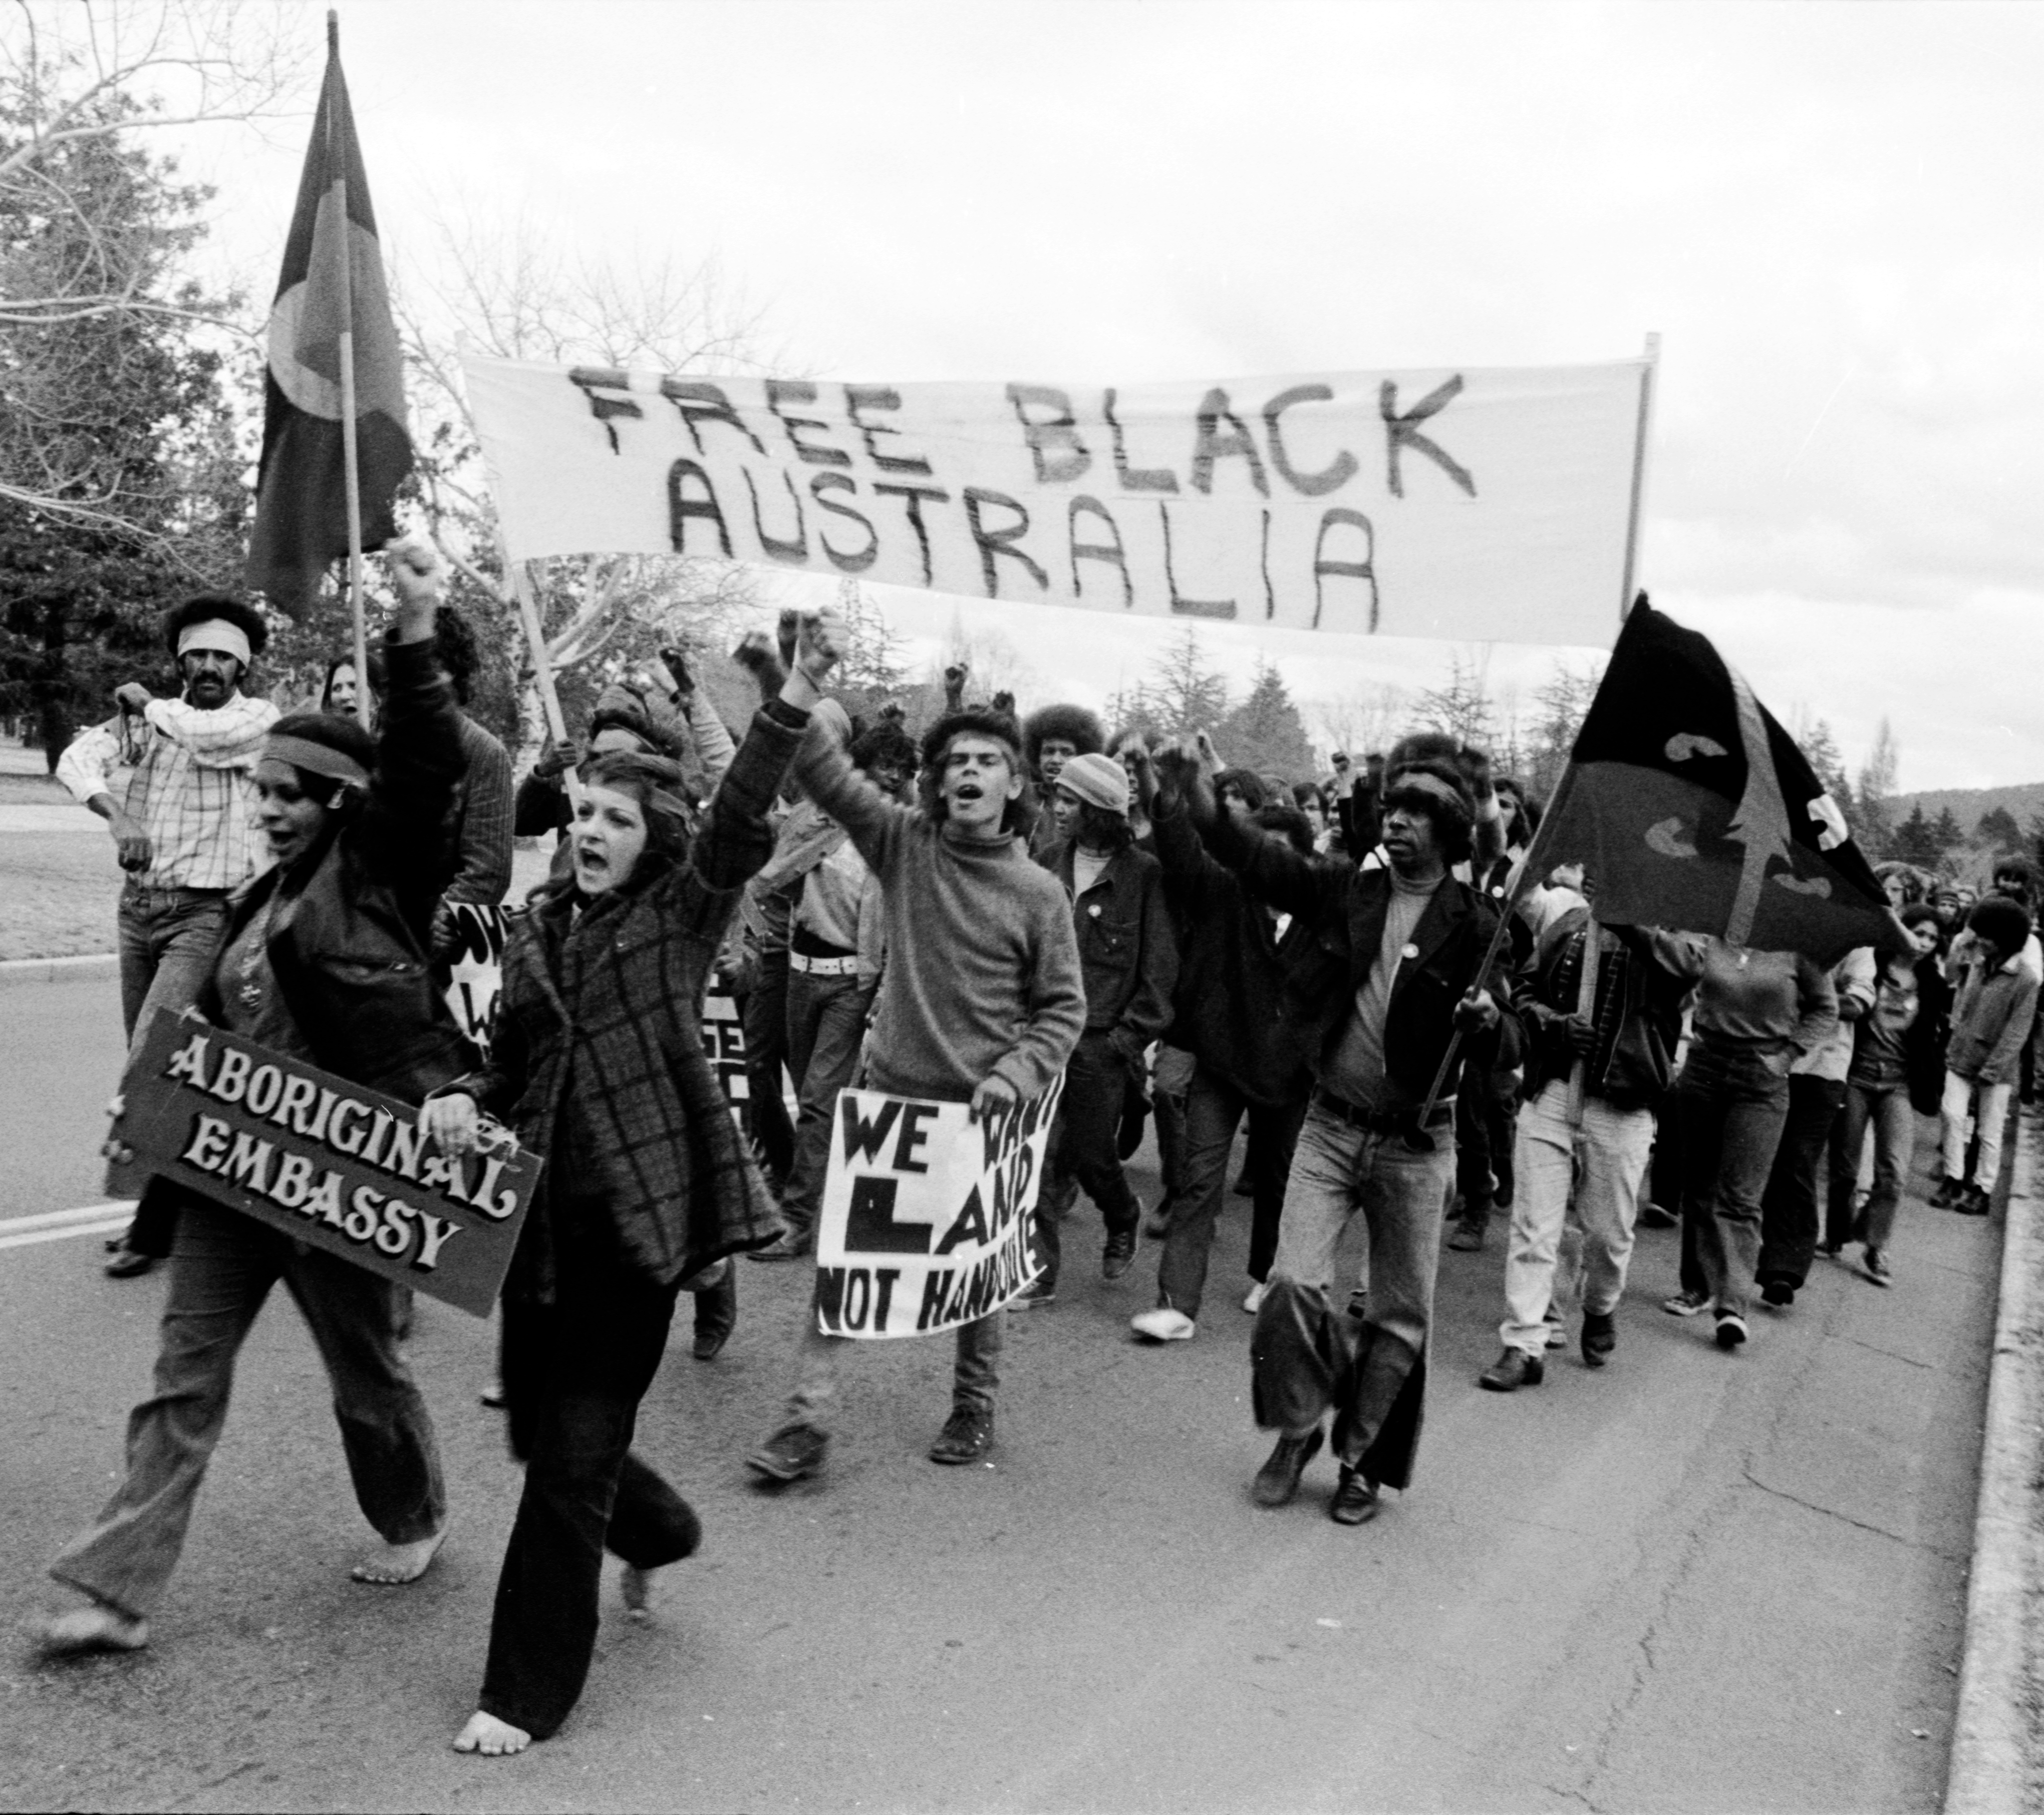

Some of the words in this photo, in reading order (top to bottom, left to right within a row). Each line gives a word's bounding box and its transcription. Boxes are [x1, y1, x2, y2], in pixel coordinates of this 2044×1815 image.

[568, 366, 933, 476] FREE
[1005, 373, 1478, 499] BLACK
[668, 457, 1378, 634] AUSTRALIA
[165, 1033, 517, 1219] ABORIGINAL
[181, 1112, 464, 1270] EMBASSY
[841, 1096, 940, 1173] WE
[844, 1141, 1034, 1256] LAND
[815, 1266, 901, 1333] NOT
